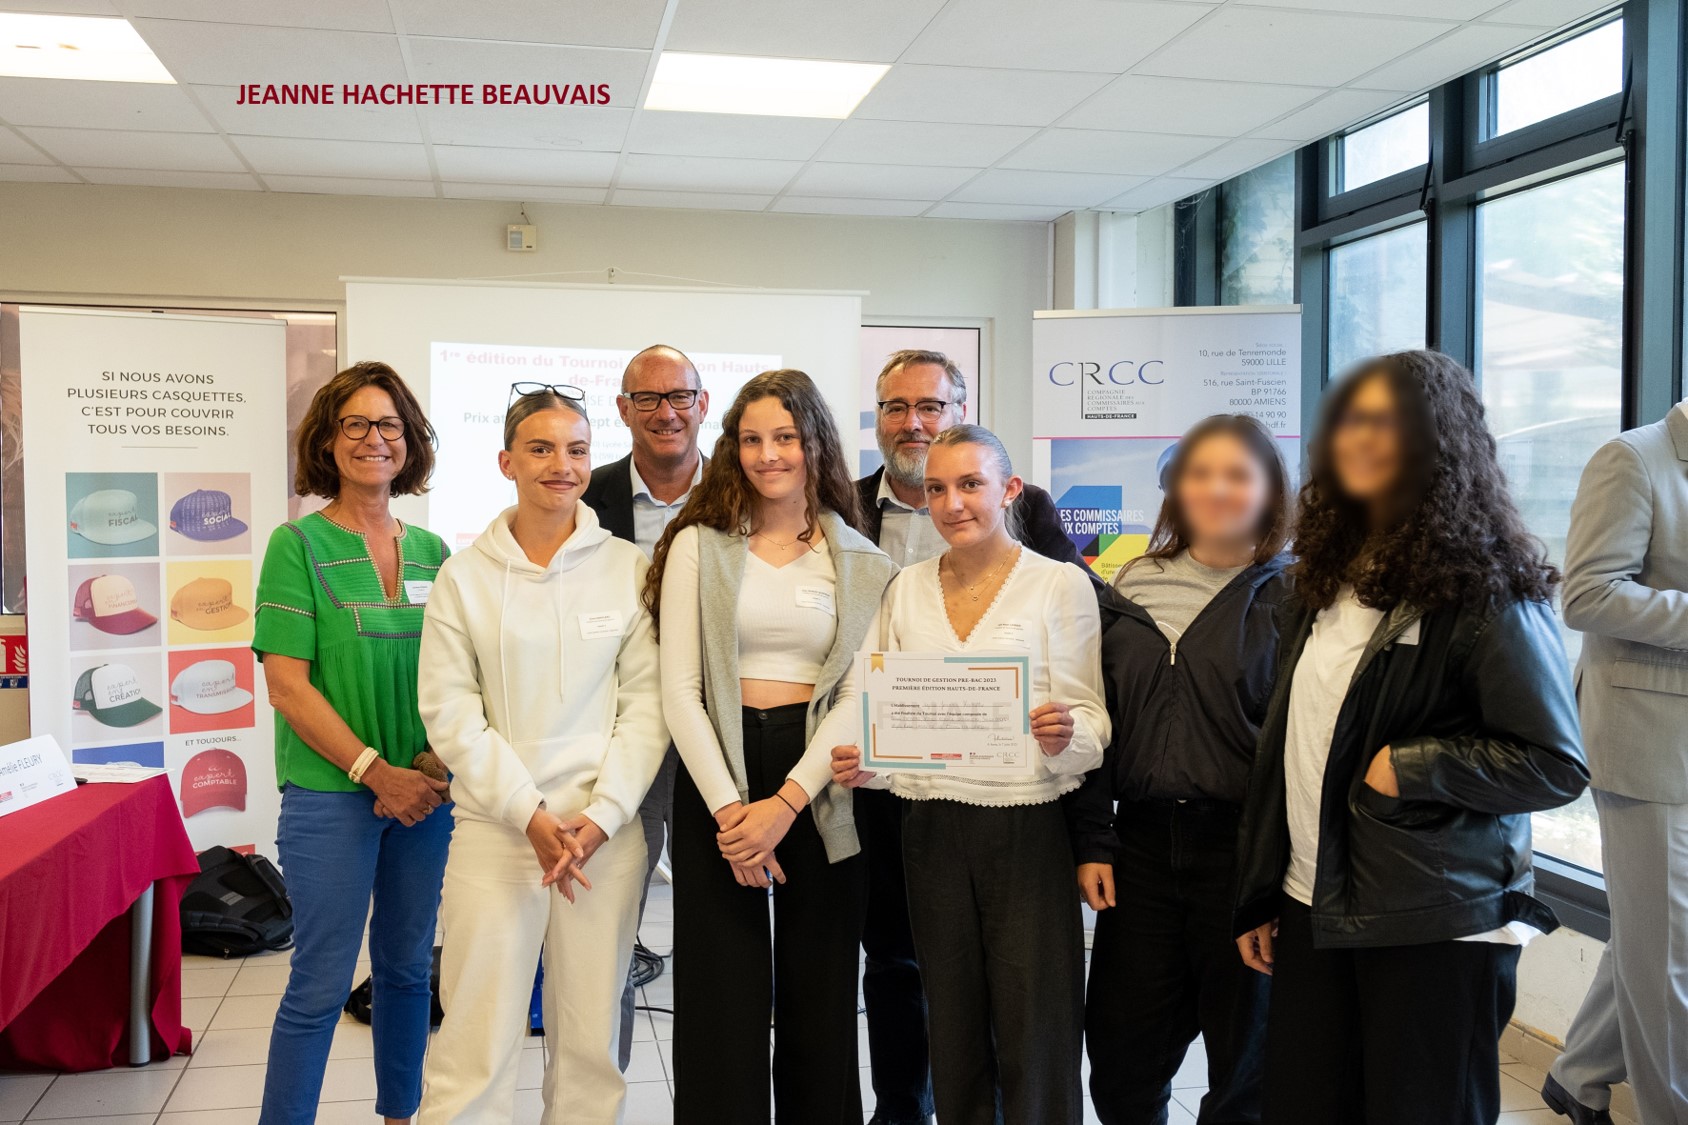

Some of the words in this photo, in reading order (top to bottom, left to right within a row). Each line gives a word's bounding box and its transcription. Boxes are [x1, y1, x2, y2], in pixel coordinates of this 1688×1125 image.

[1199, 349, 1210, 357] 10,
[466, 351, 527, 366] édition
[532, 354, 554, 367] du
[559, 355, 623, 369] Tournoi
[102, 371, 115, 381] SI
[120, 372, 161, 383] NOUS
[165, 373, 214, 384] AVONS
[1049, 360, 1164, 387] CRCC
[568, 374, 621, 387] de-Fra
[67, 388, 148, 400] PLUSIEURS
[152, 390, 247, 403] CASQUETTES,
[586, 395, 604, 406] ISE
[81, 406, 122, 417] C'EST
[125, 407, 167, 418] POUR
[170, 408, 234, 419] COUVRIR
[464, 412, 489, 424] Prix
[590, 417, 610, 429] ept
[88, 424, 127, 434] TOUS
[131, 424, 160, 435] VOS
[165, 425, 230, 436] BESOINS.
[108, 513, 138, 527] FISCAL
[1060, 509, 1072, 521] ES
[1074, 509, 1144, 522] COMMISSAIRES
[1075, 522, 1118, 534] COMPTES
[196, 735, 242, 746] TOUJOURS...
[18, 754, 43, 770] FLEURY
[192, 778, 237, 789] COMPTABLE
